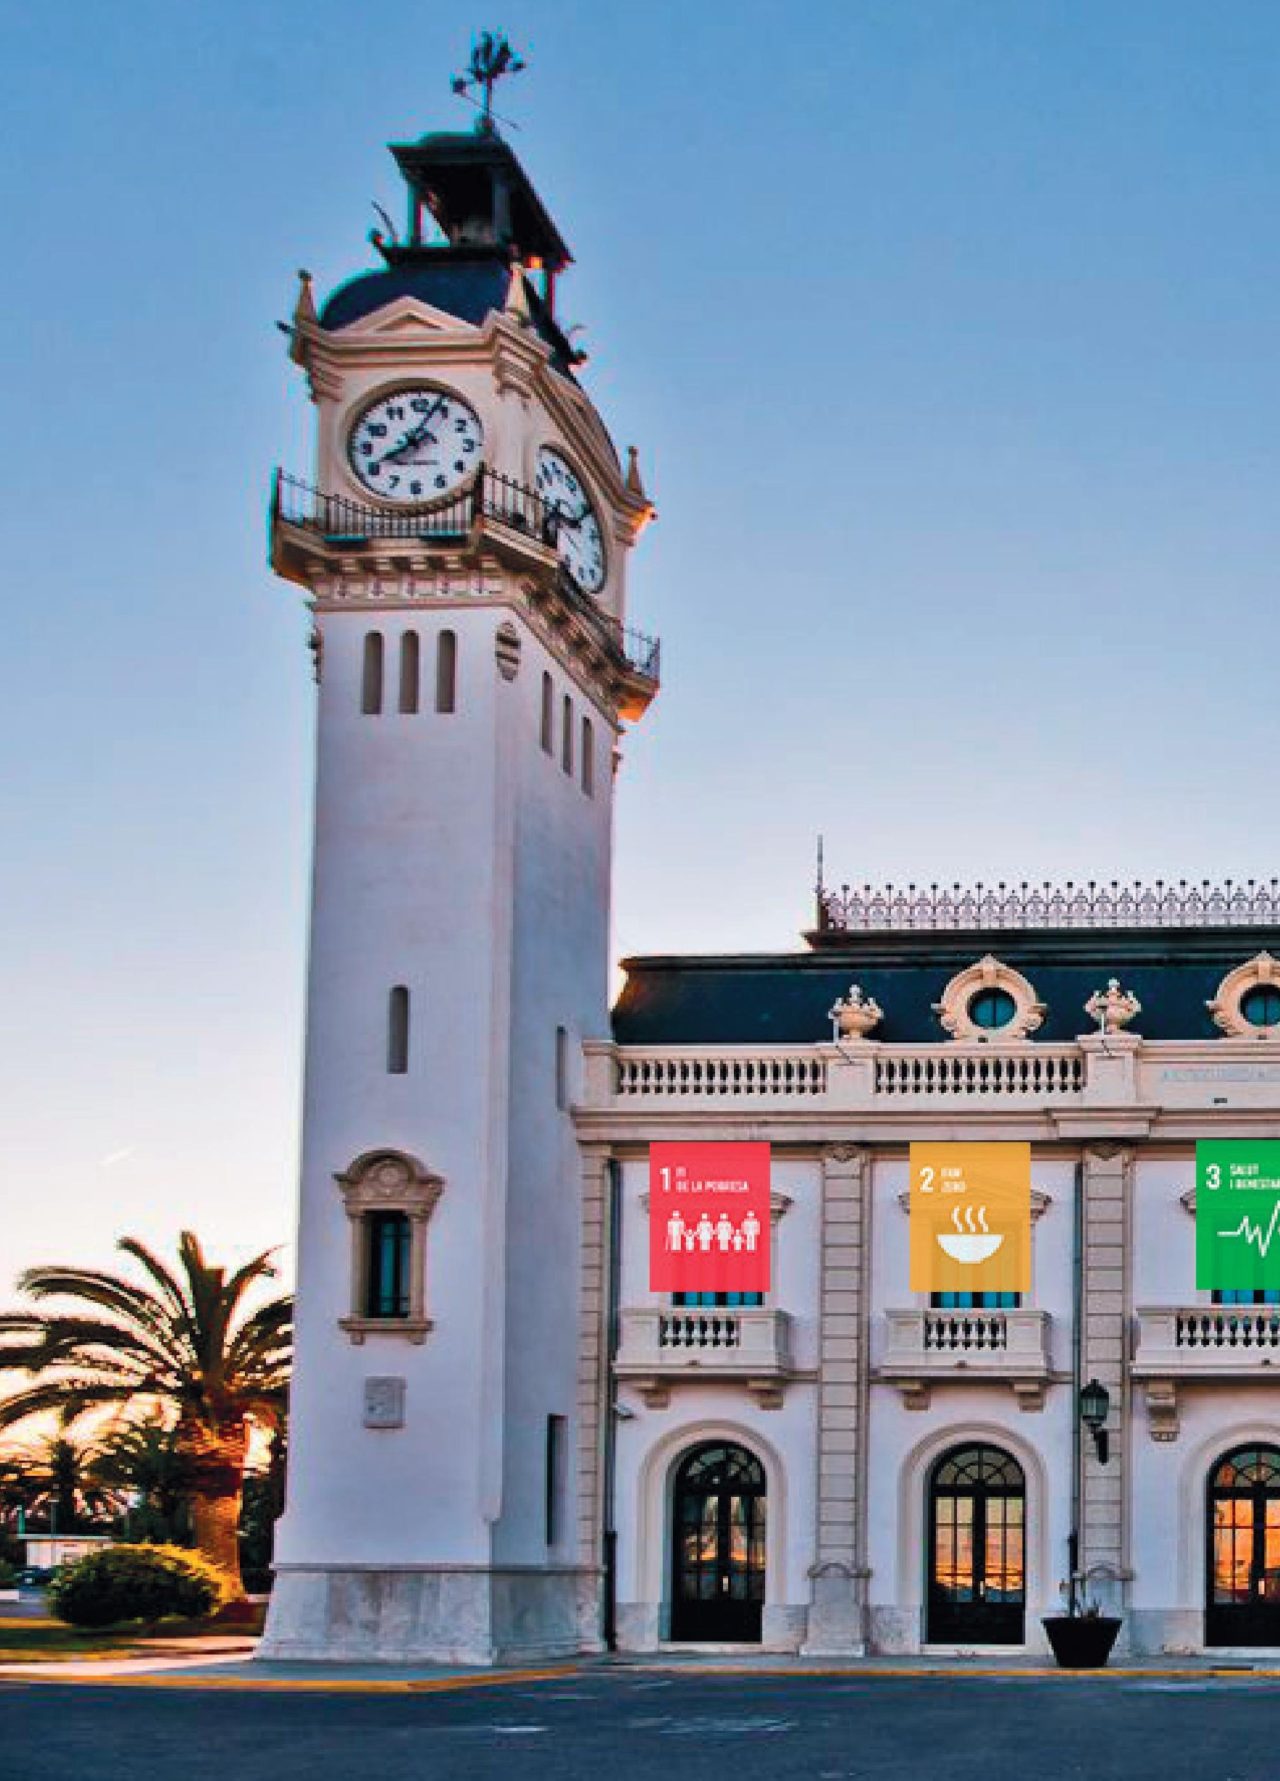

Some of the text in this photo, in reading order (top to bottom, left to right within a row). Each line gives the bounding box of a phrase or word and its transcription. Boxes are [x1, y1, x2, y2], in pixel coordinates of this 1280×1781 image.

[660, 1167, 671, 1193] 1
[920, 1167, 934, 1193] 2
[1206, 1163, 1221, 1190] 3
